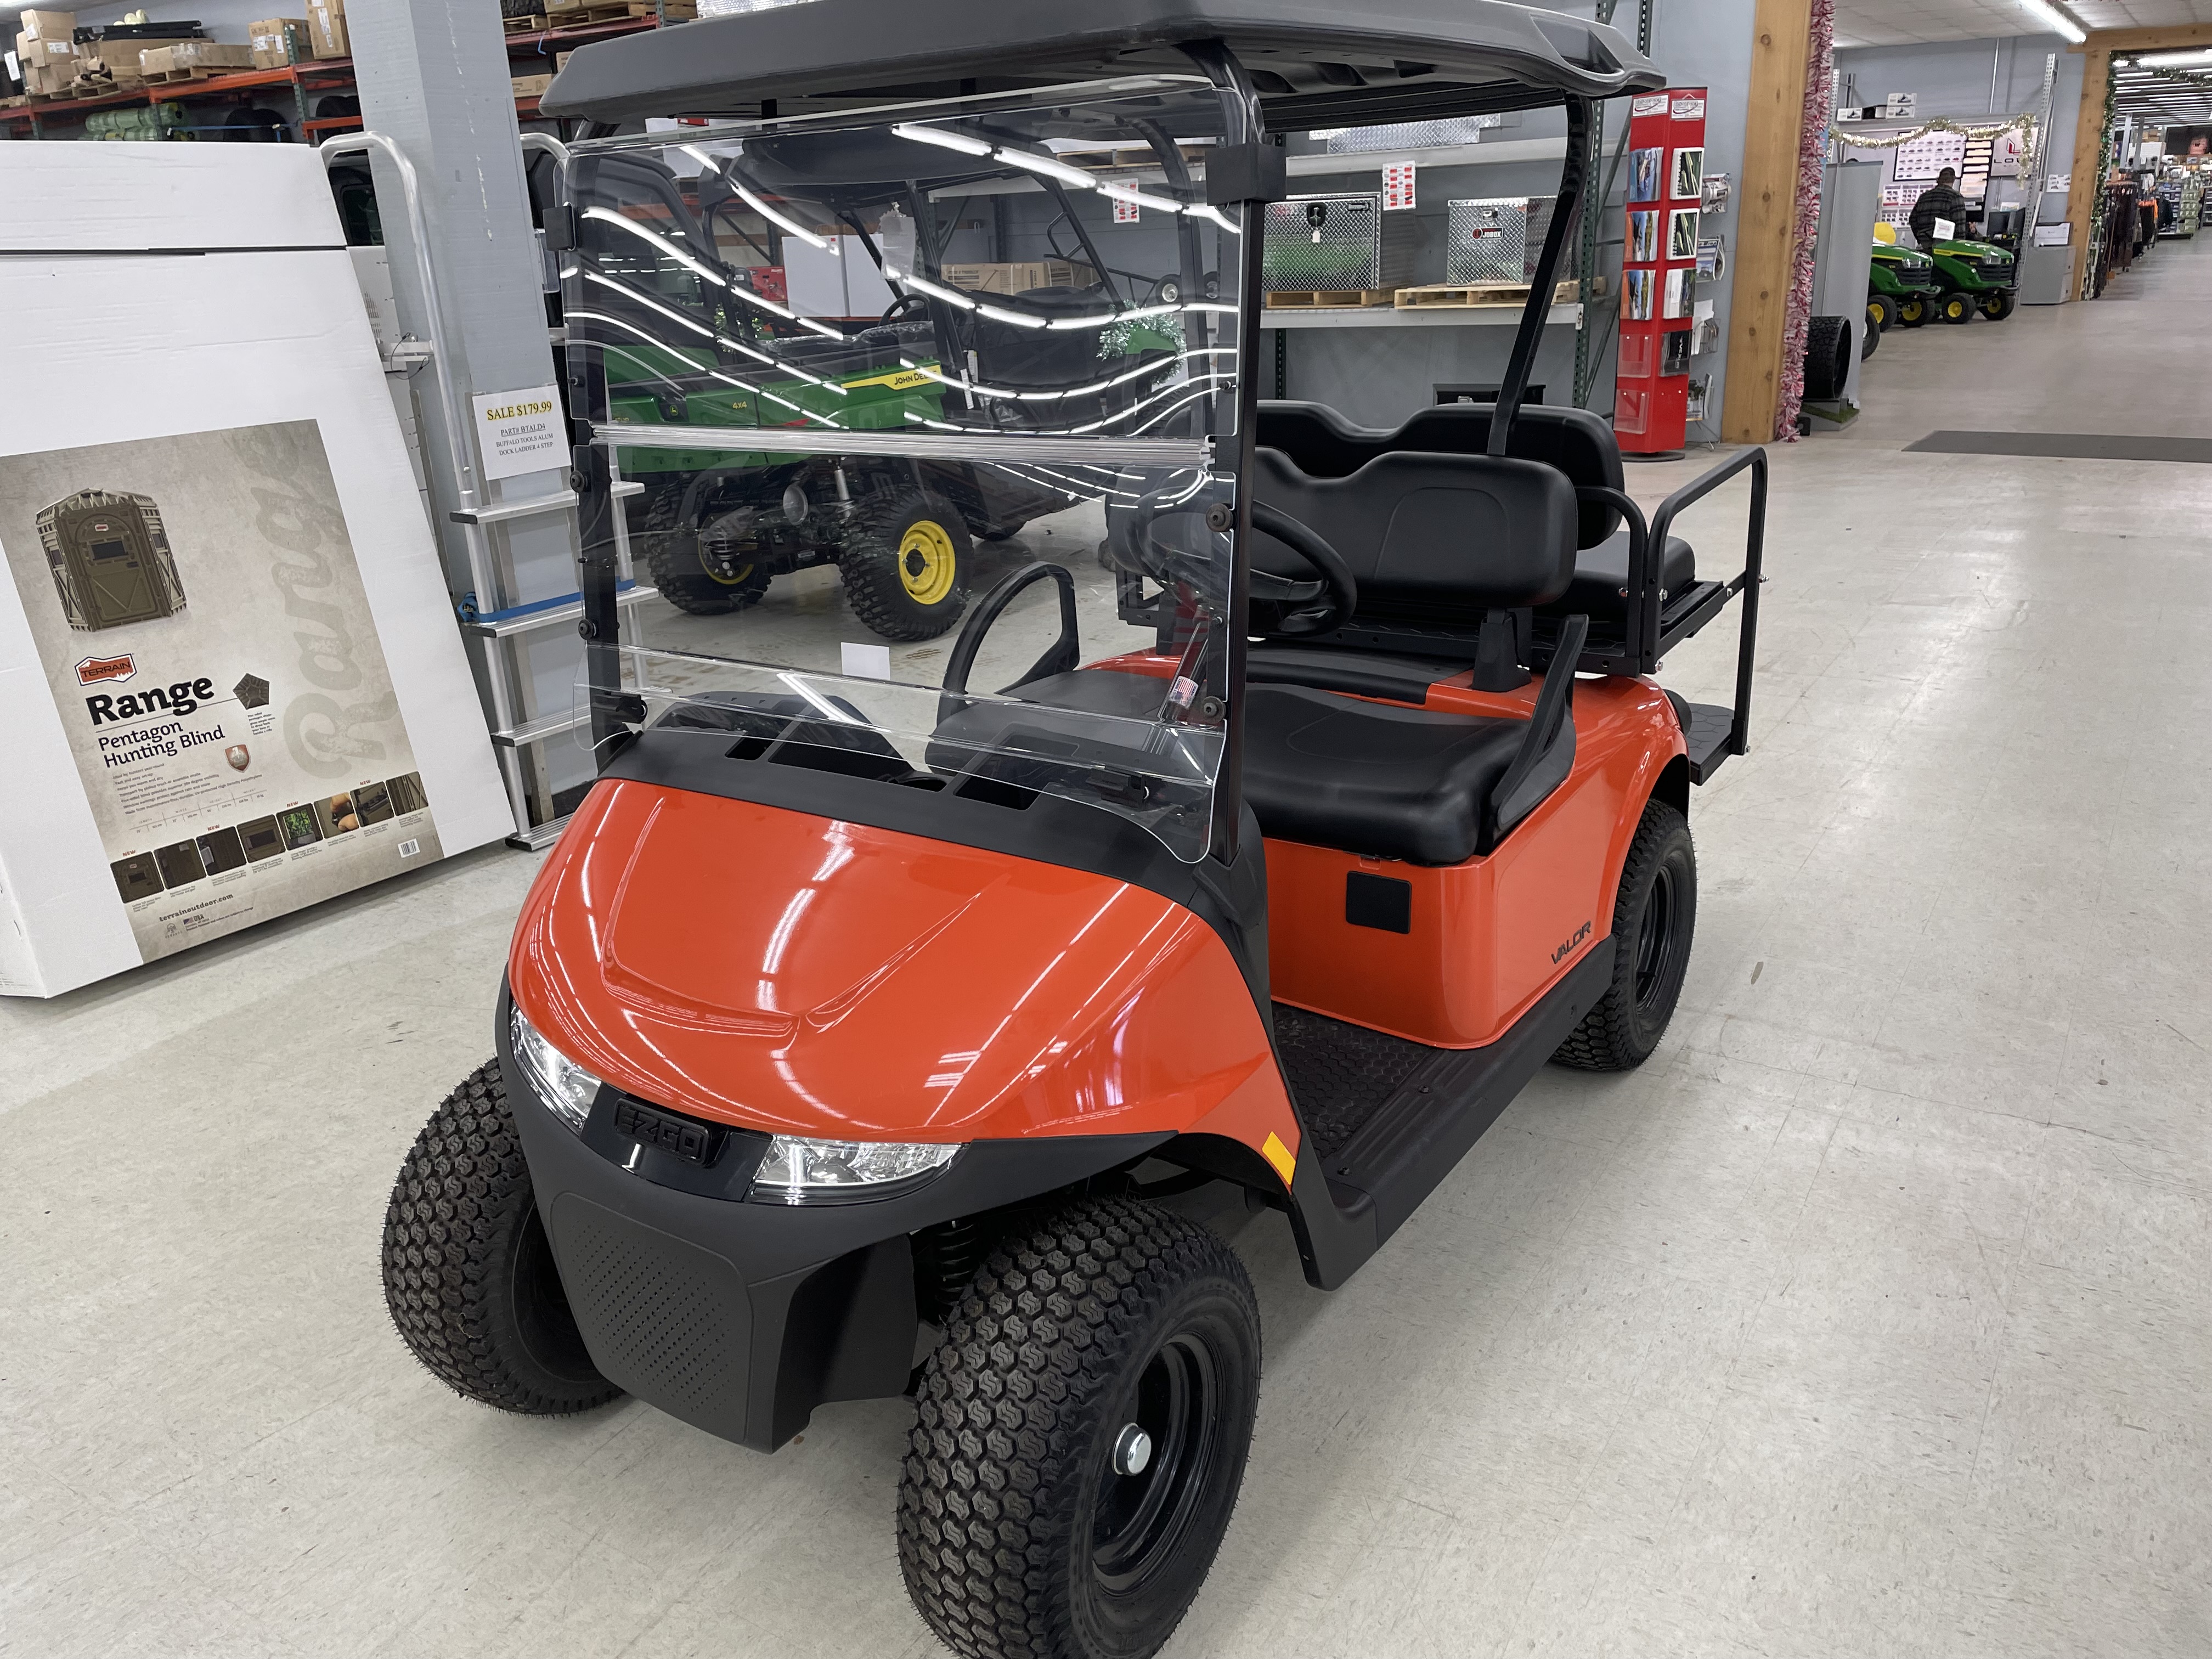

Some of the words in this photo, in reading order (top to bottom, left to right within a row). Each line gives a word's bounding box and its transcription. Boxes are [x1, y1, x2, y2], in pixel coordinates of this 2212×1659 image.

[894, 375, 913, 385] JOHN
[487, 407, 515, 420] SALE
[517, 401, 552, 416] $179.99
[501, 427, 520, 436] PART#
[521, 423, 545, 433] BTALD4
[496, 439, 520, 447] BUFFALO
[515, 444, 536, 453] LADDER
[81, 661, 132, 678] TERRAIN
[86, 678, 215, 726] Range
[98, 722, 183, 752] Pentagon
[104, 740, 178, 768] Hunting
[179, 724, 225, 748] Blind
[159, 894, 233, 922] terrainoutdoor.com
[1551, 921, 1591, 964] VALOR
[615, 1105, 704, 1158] EZGO
